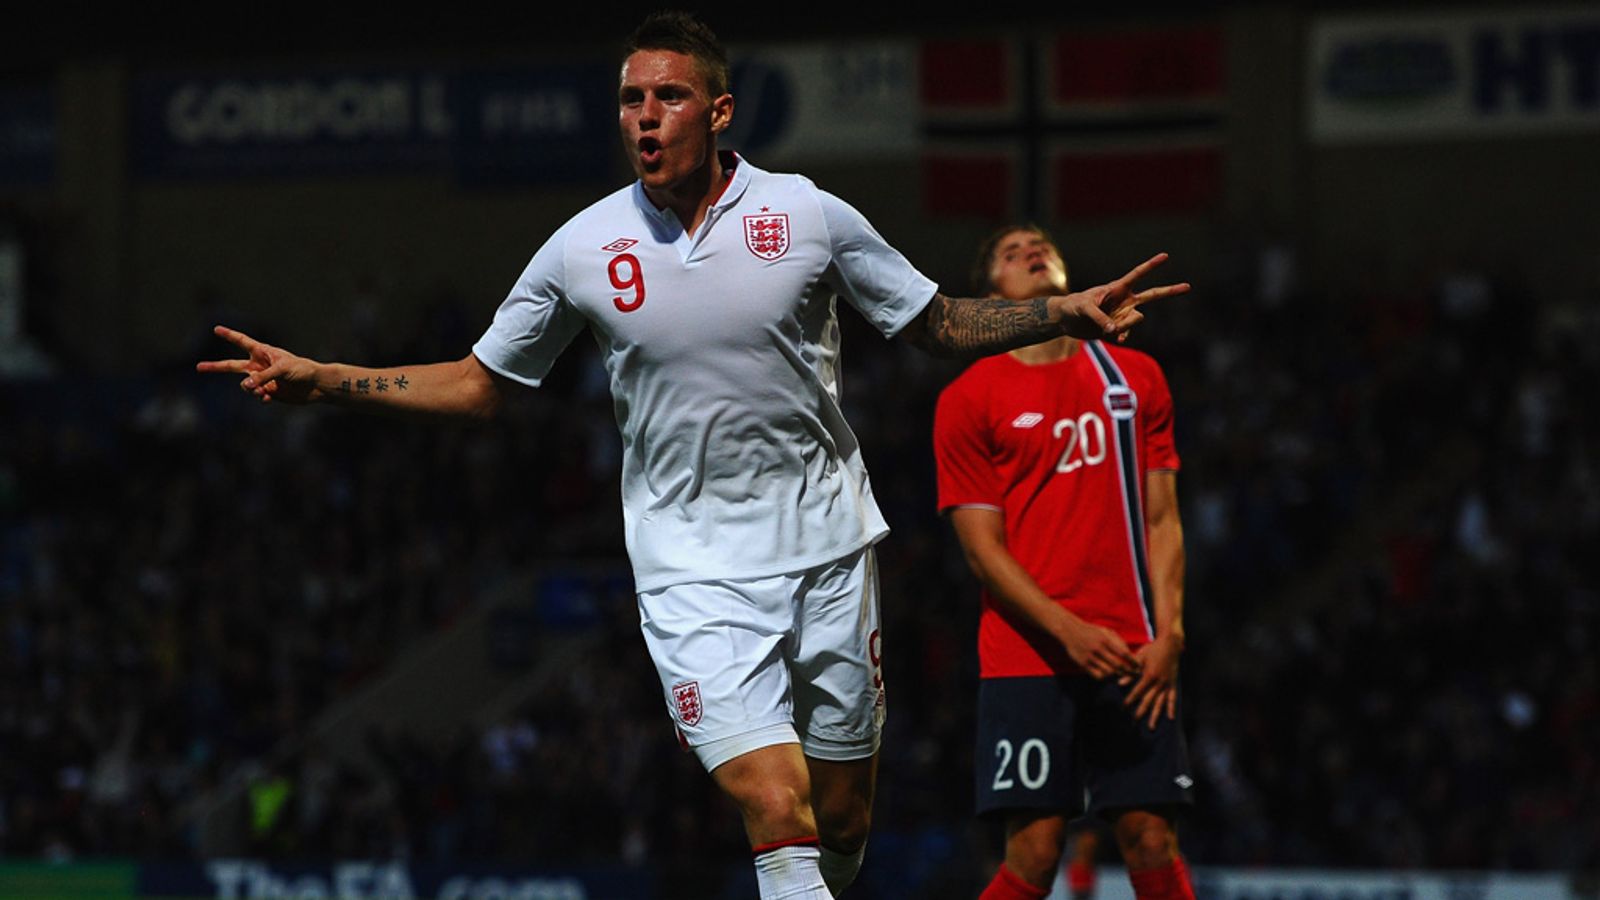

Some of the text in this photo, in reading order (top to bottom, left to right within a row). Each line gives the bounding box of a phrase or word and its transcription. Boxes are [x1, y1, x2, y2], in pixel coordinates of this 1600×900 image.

[608, 253, 645, 313] 9
[1052, 411, 1107, 474] 20
[992, 738, 1050, 791] 20
[205, 857, 588, 900] TheFAcom
